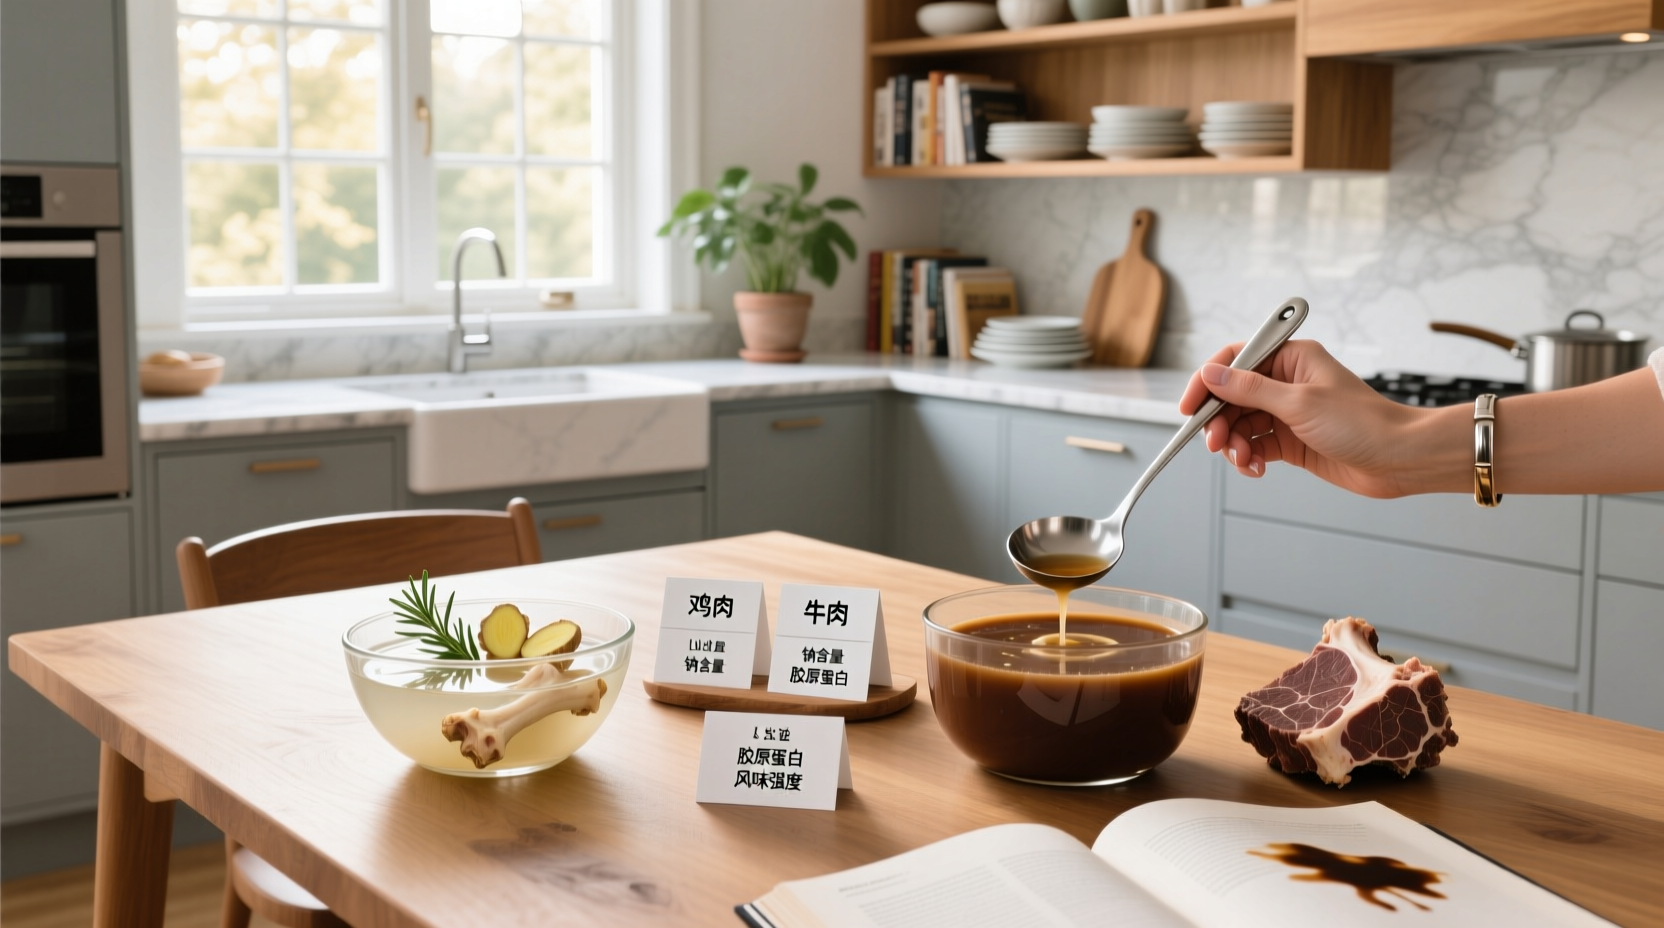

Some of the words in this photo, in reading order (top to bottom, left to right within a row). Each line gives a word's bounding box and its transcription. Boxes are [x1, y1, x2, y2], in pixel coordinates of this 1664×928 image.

[688, 593, 734, 619] 鸡肉
[804, 599, 849, 627] 牛肉
[790, 667, 848, 687] 胶原蛋白
[737, 747, 803, 768] 胶原蛋白
[734, 770, 803, 792] 风味强度
